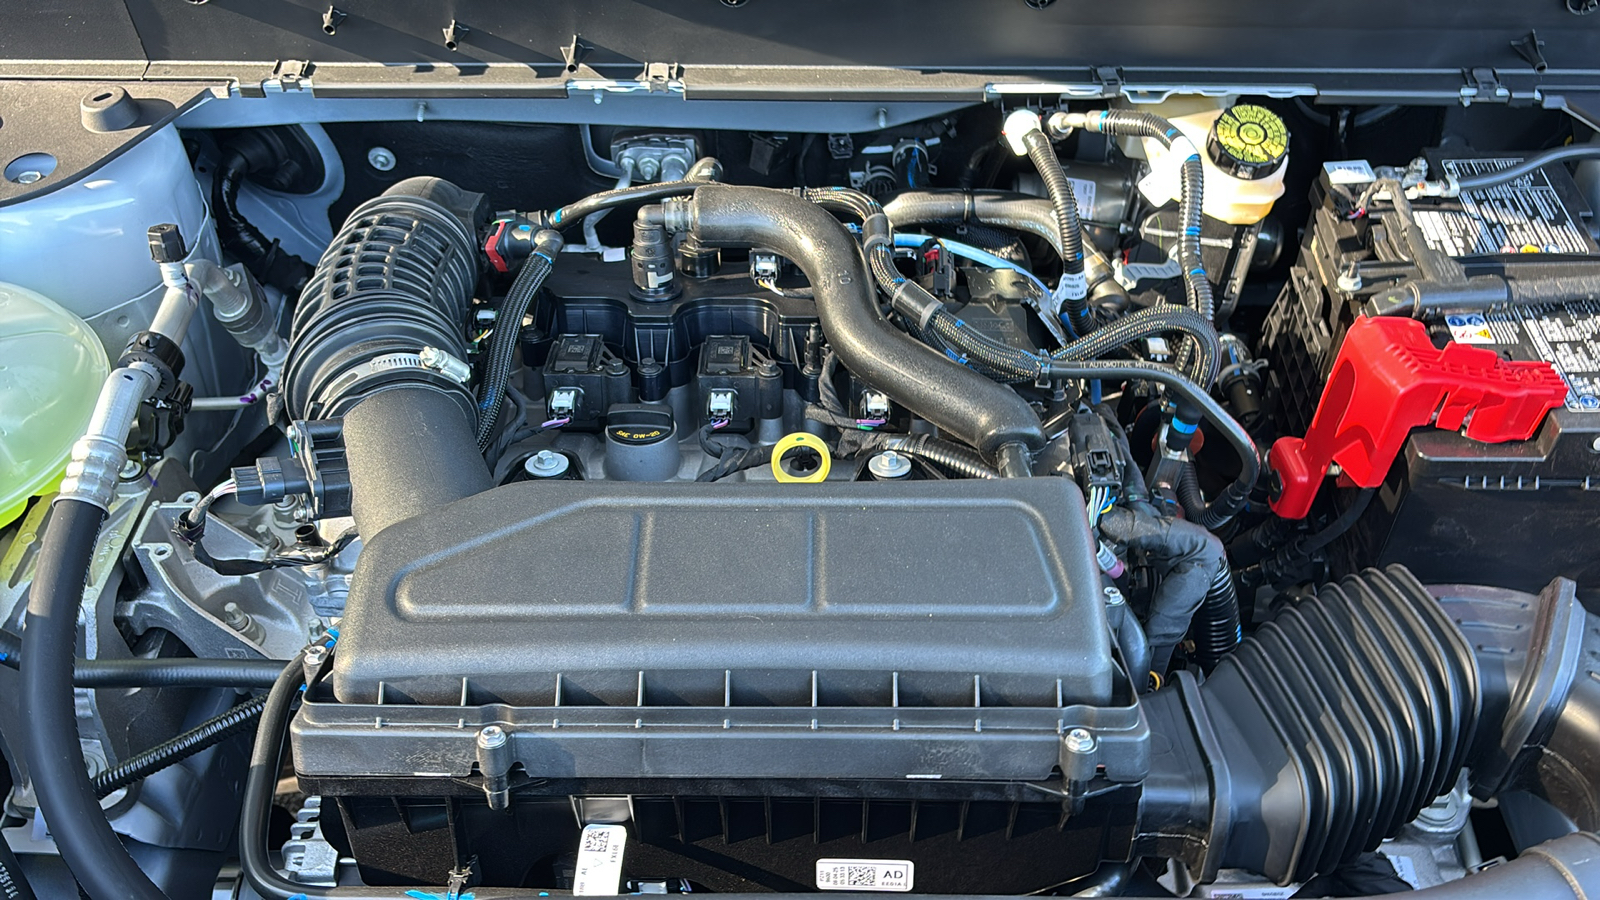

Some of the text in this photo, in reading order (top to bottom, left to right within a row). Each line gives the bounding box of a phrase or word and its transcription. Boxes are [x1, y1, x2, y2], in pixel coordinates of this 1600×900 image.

[1089, 361, 1132, 369] AUTOMOTIVE
[616, 430, 631, 438] SAE
[882, 870, 904, 879] AD
